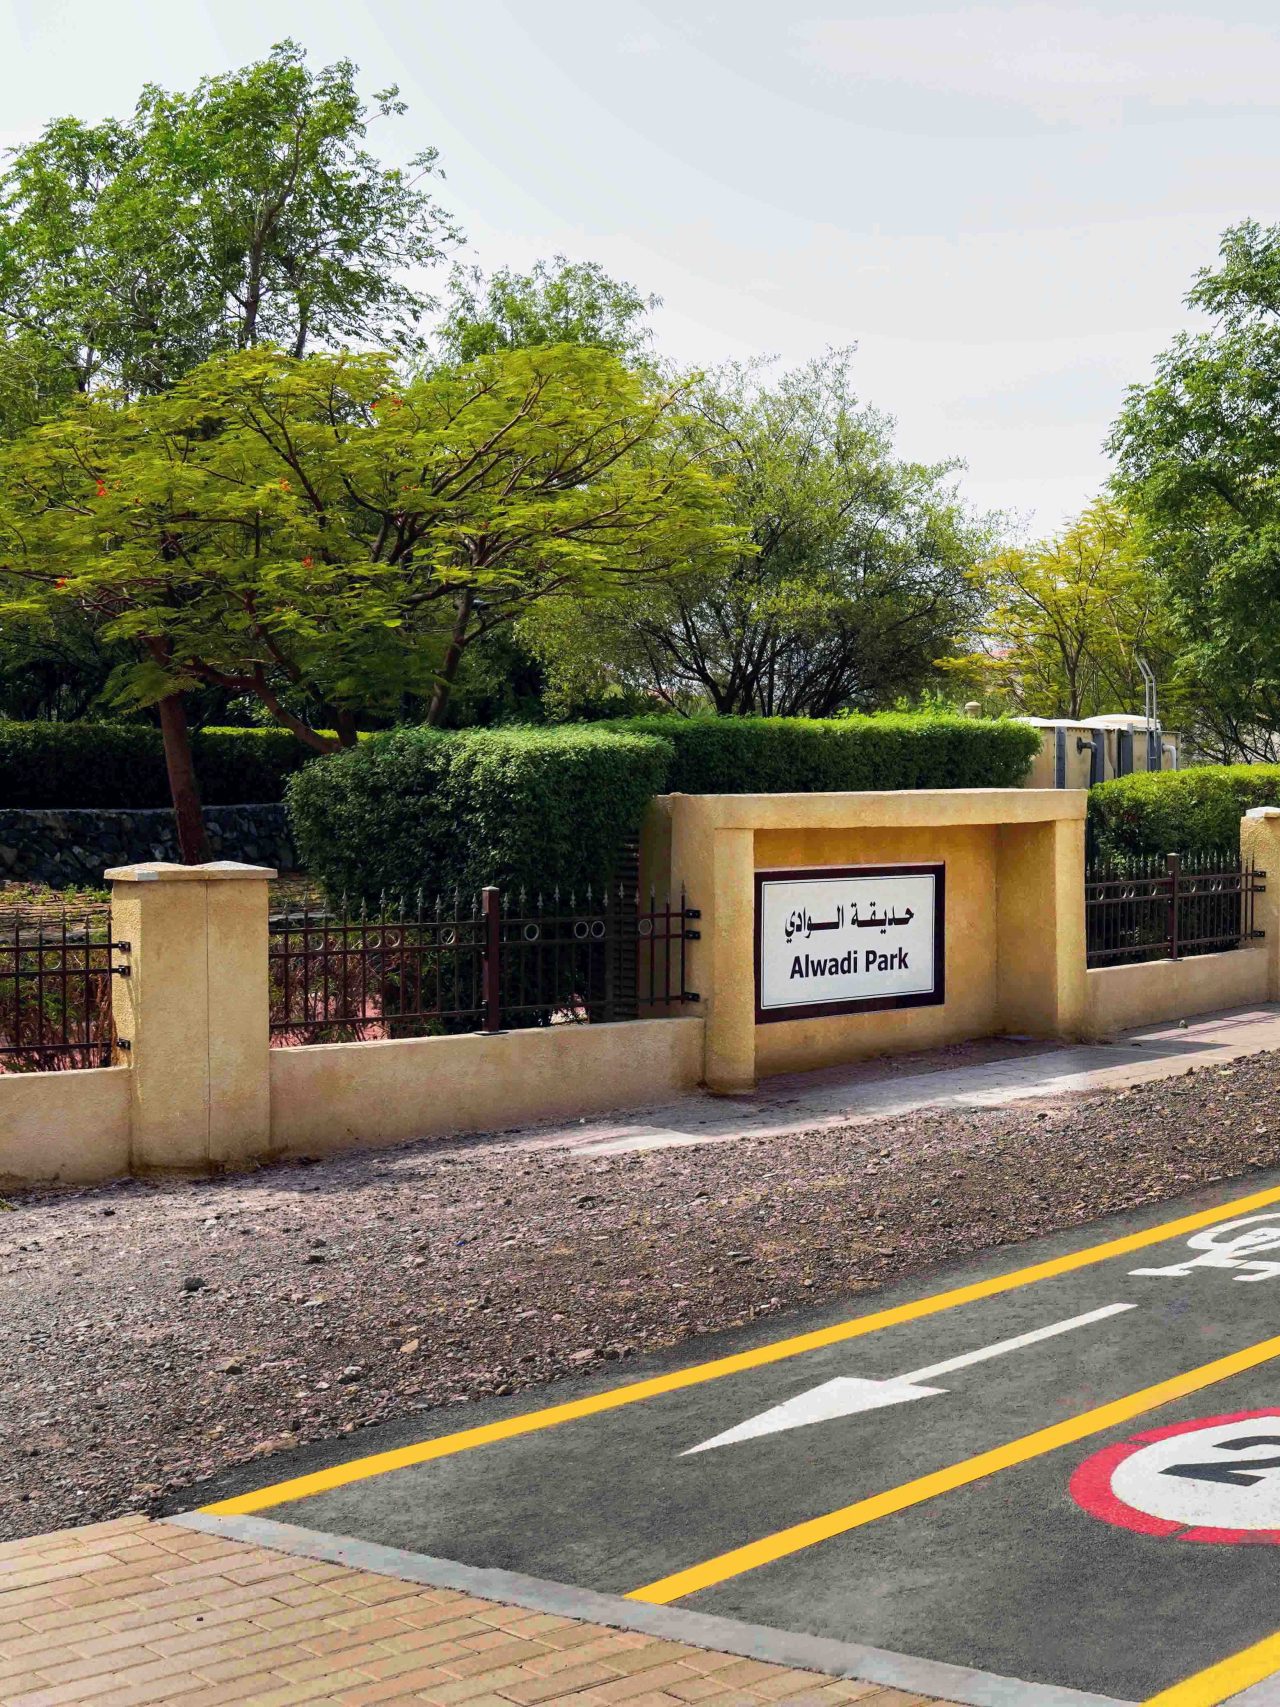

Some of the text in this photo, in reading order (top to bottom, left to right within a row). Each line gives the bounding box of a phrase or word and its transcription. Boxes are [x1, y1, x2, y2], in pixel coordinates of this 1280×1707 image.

[850, 901, 915, 934] حديقة
[789, 947, 909, 979] Alwadi Park
